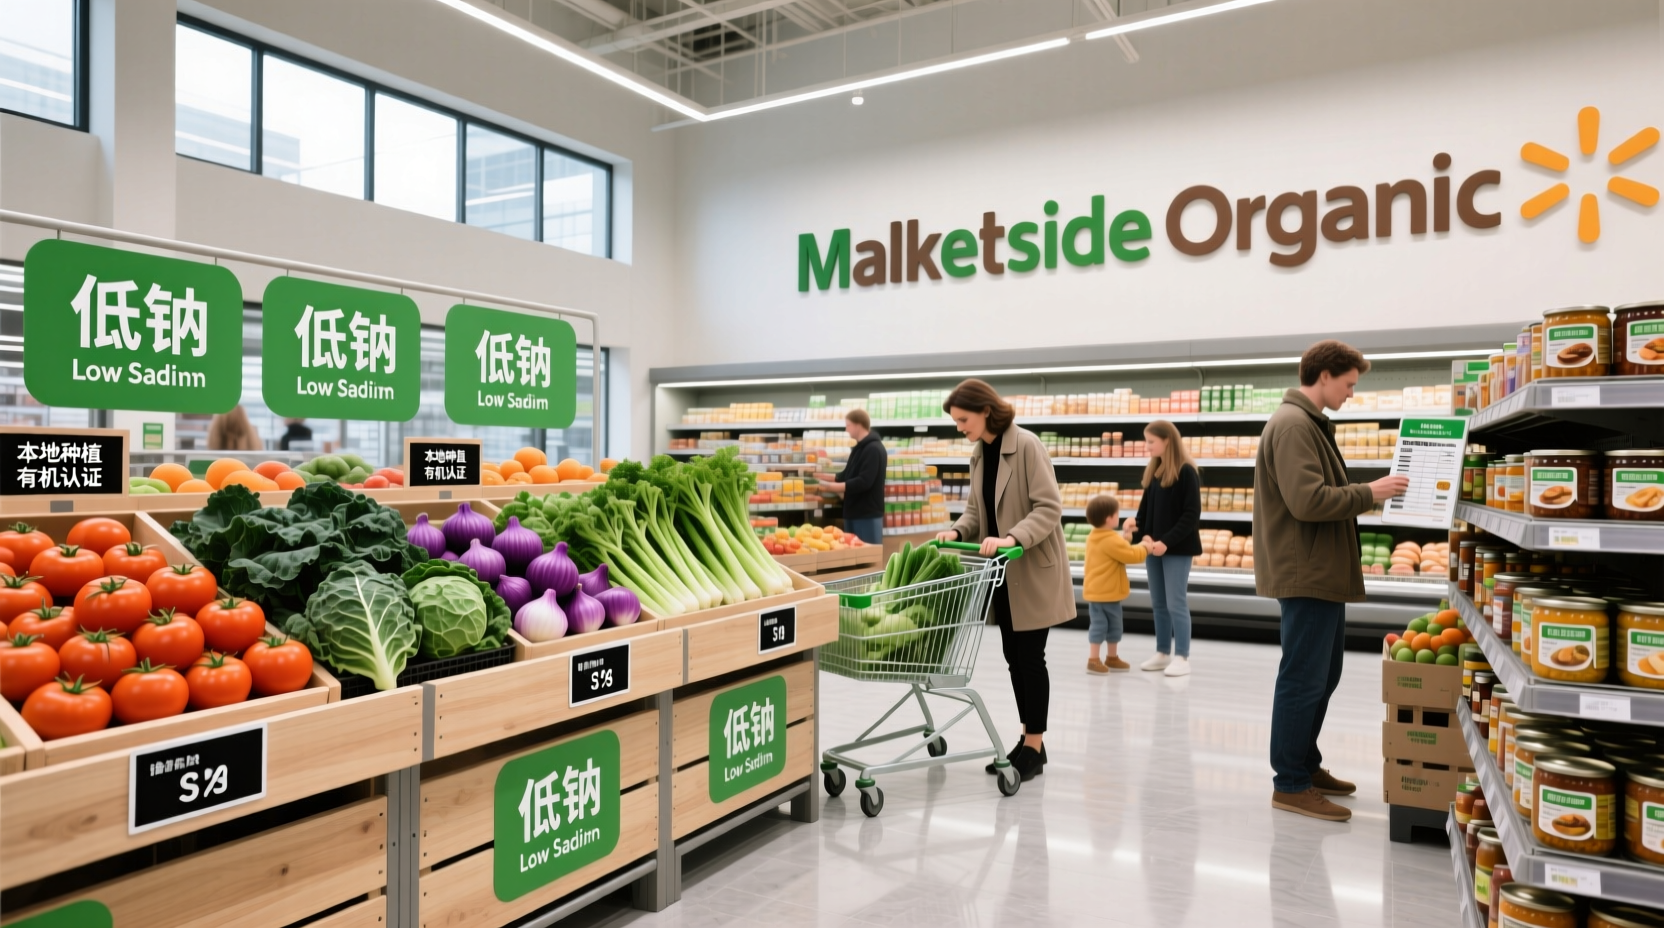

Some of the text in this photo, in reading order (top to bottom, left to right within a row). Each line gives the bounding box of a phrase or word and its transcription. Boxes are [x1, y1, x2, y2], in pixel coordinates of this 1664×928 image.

[798, 152, 1501, 292] Malketside Organic
[71, 274, 207, 357] 低钠
[294, 304, 396, 374] 低钠
[475, 329, 551, 388] 低钠
[73, 358, 122, 382] Low
[297, 376, 333, 396] Low
[478, 390, 504, 408] Low
[17, 441, 103, 464] 本地种植
[16, 466, 102, 488] 有机认证
[723, 697, 775, 759] 低钠
[518, 757, 601, 843] 低钠
[520, 847, 550, 873] Low
